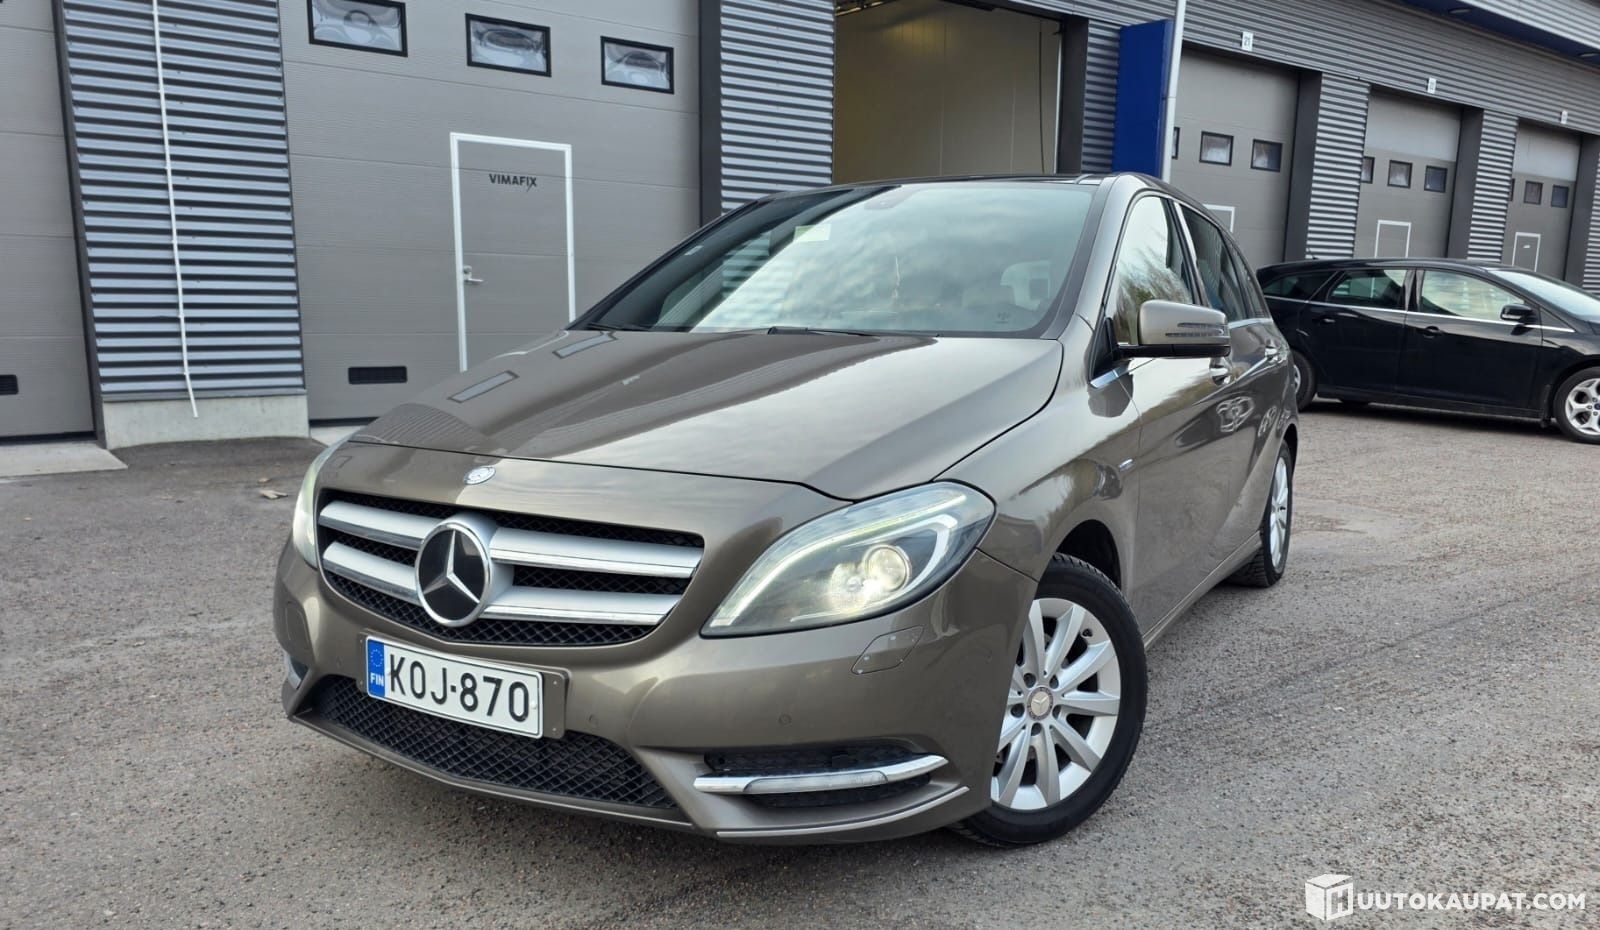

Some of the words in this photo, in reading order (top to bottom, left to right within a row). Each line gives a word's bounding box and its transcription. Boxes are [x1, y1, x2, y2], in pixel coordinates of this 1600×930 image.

[489, 173, 537, 192] VIMAFIX
[370, 672, 384, 687] FIN
[390, 654, 530, 723] KOJ-870
